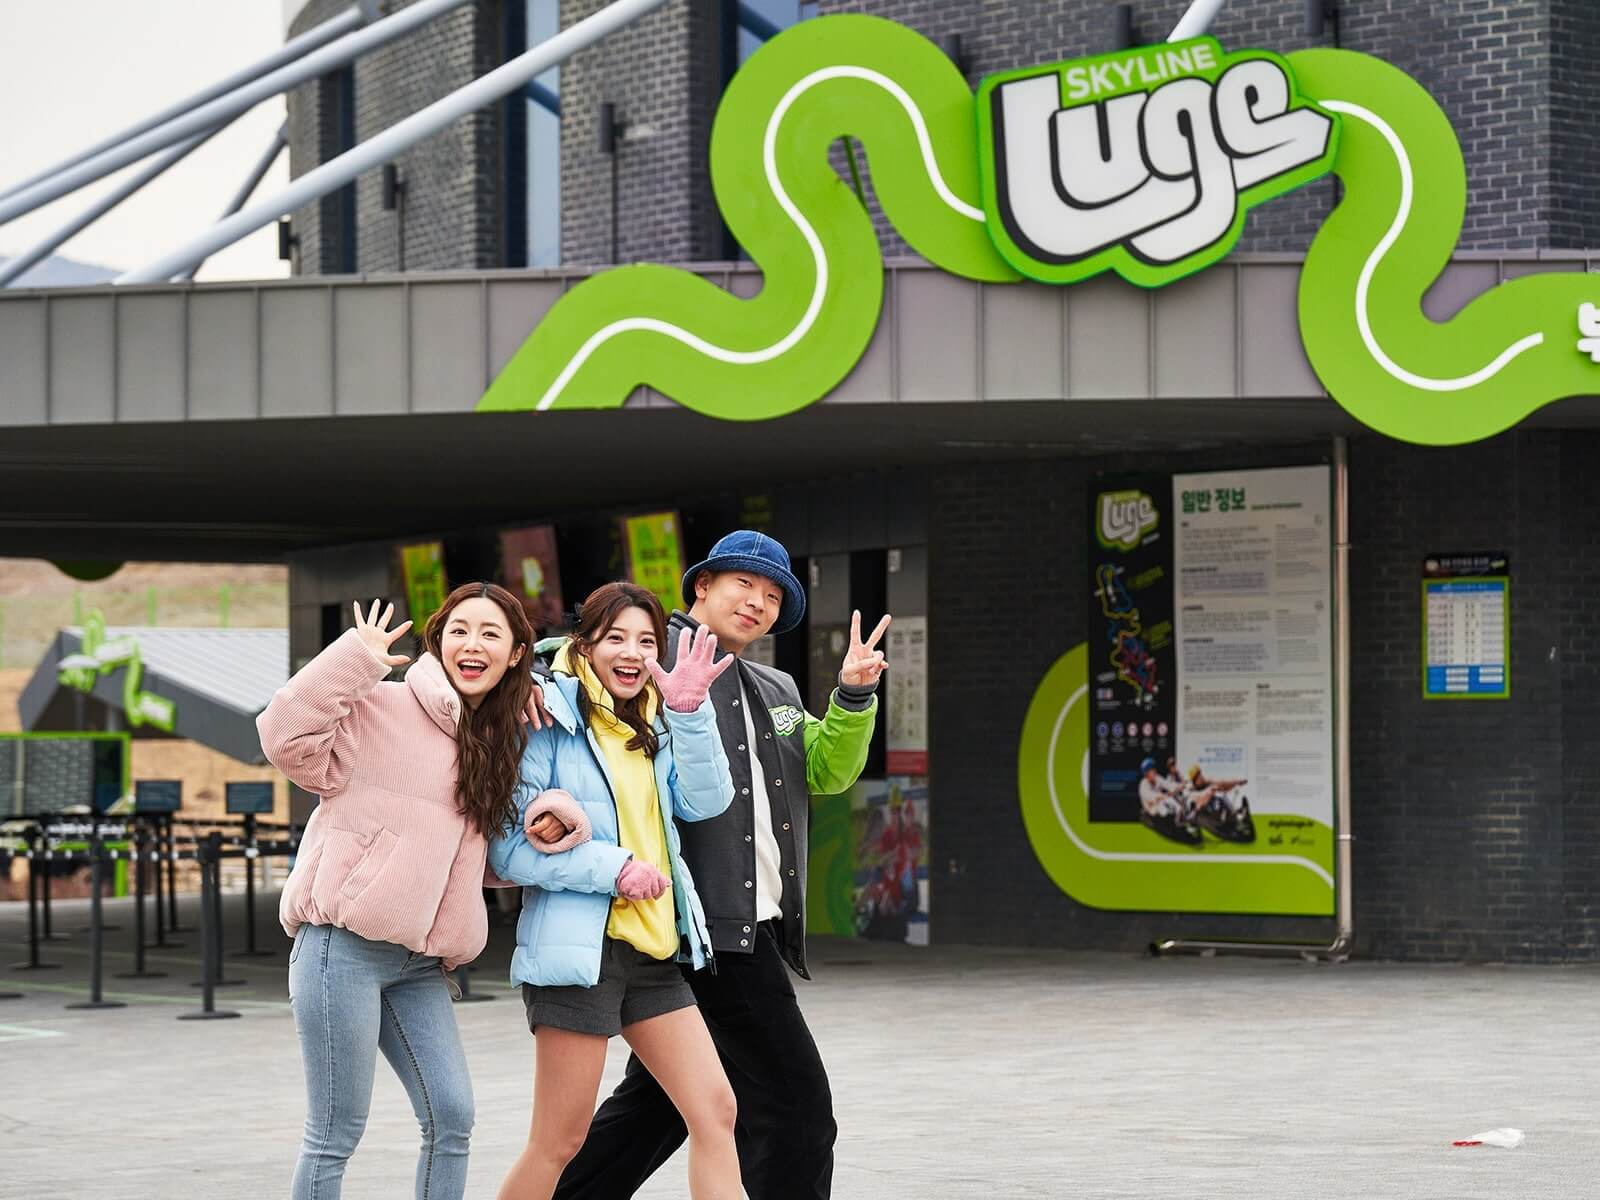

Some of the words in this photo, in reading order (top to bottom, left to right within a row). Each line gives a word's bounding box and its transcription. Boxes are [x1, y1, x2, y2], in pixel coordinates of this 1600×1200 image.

[1066, 45, 1216, 99] SKYLINE
[1181, 489, 1211, 513] 일반
[1216, 487, 1246, 512] 정보
